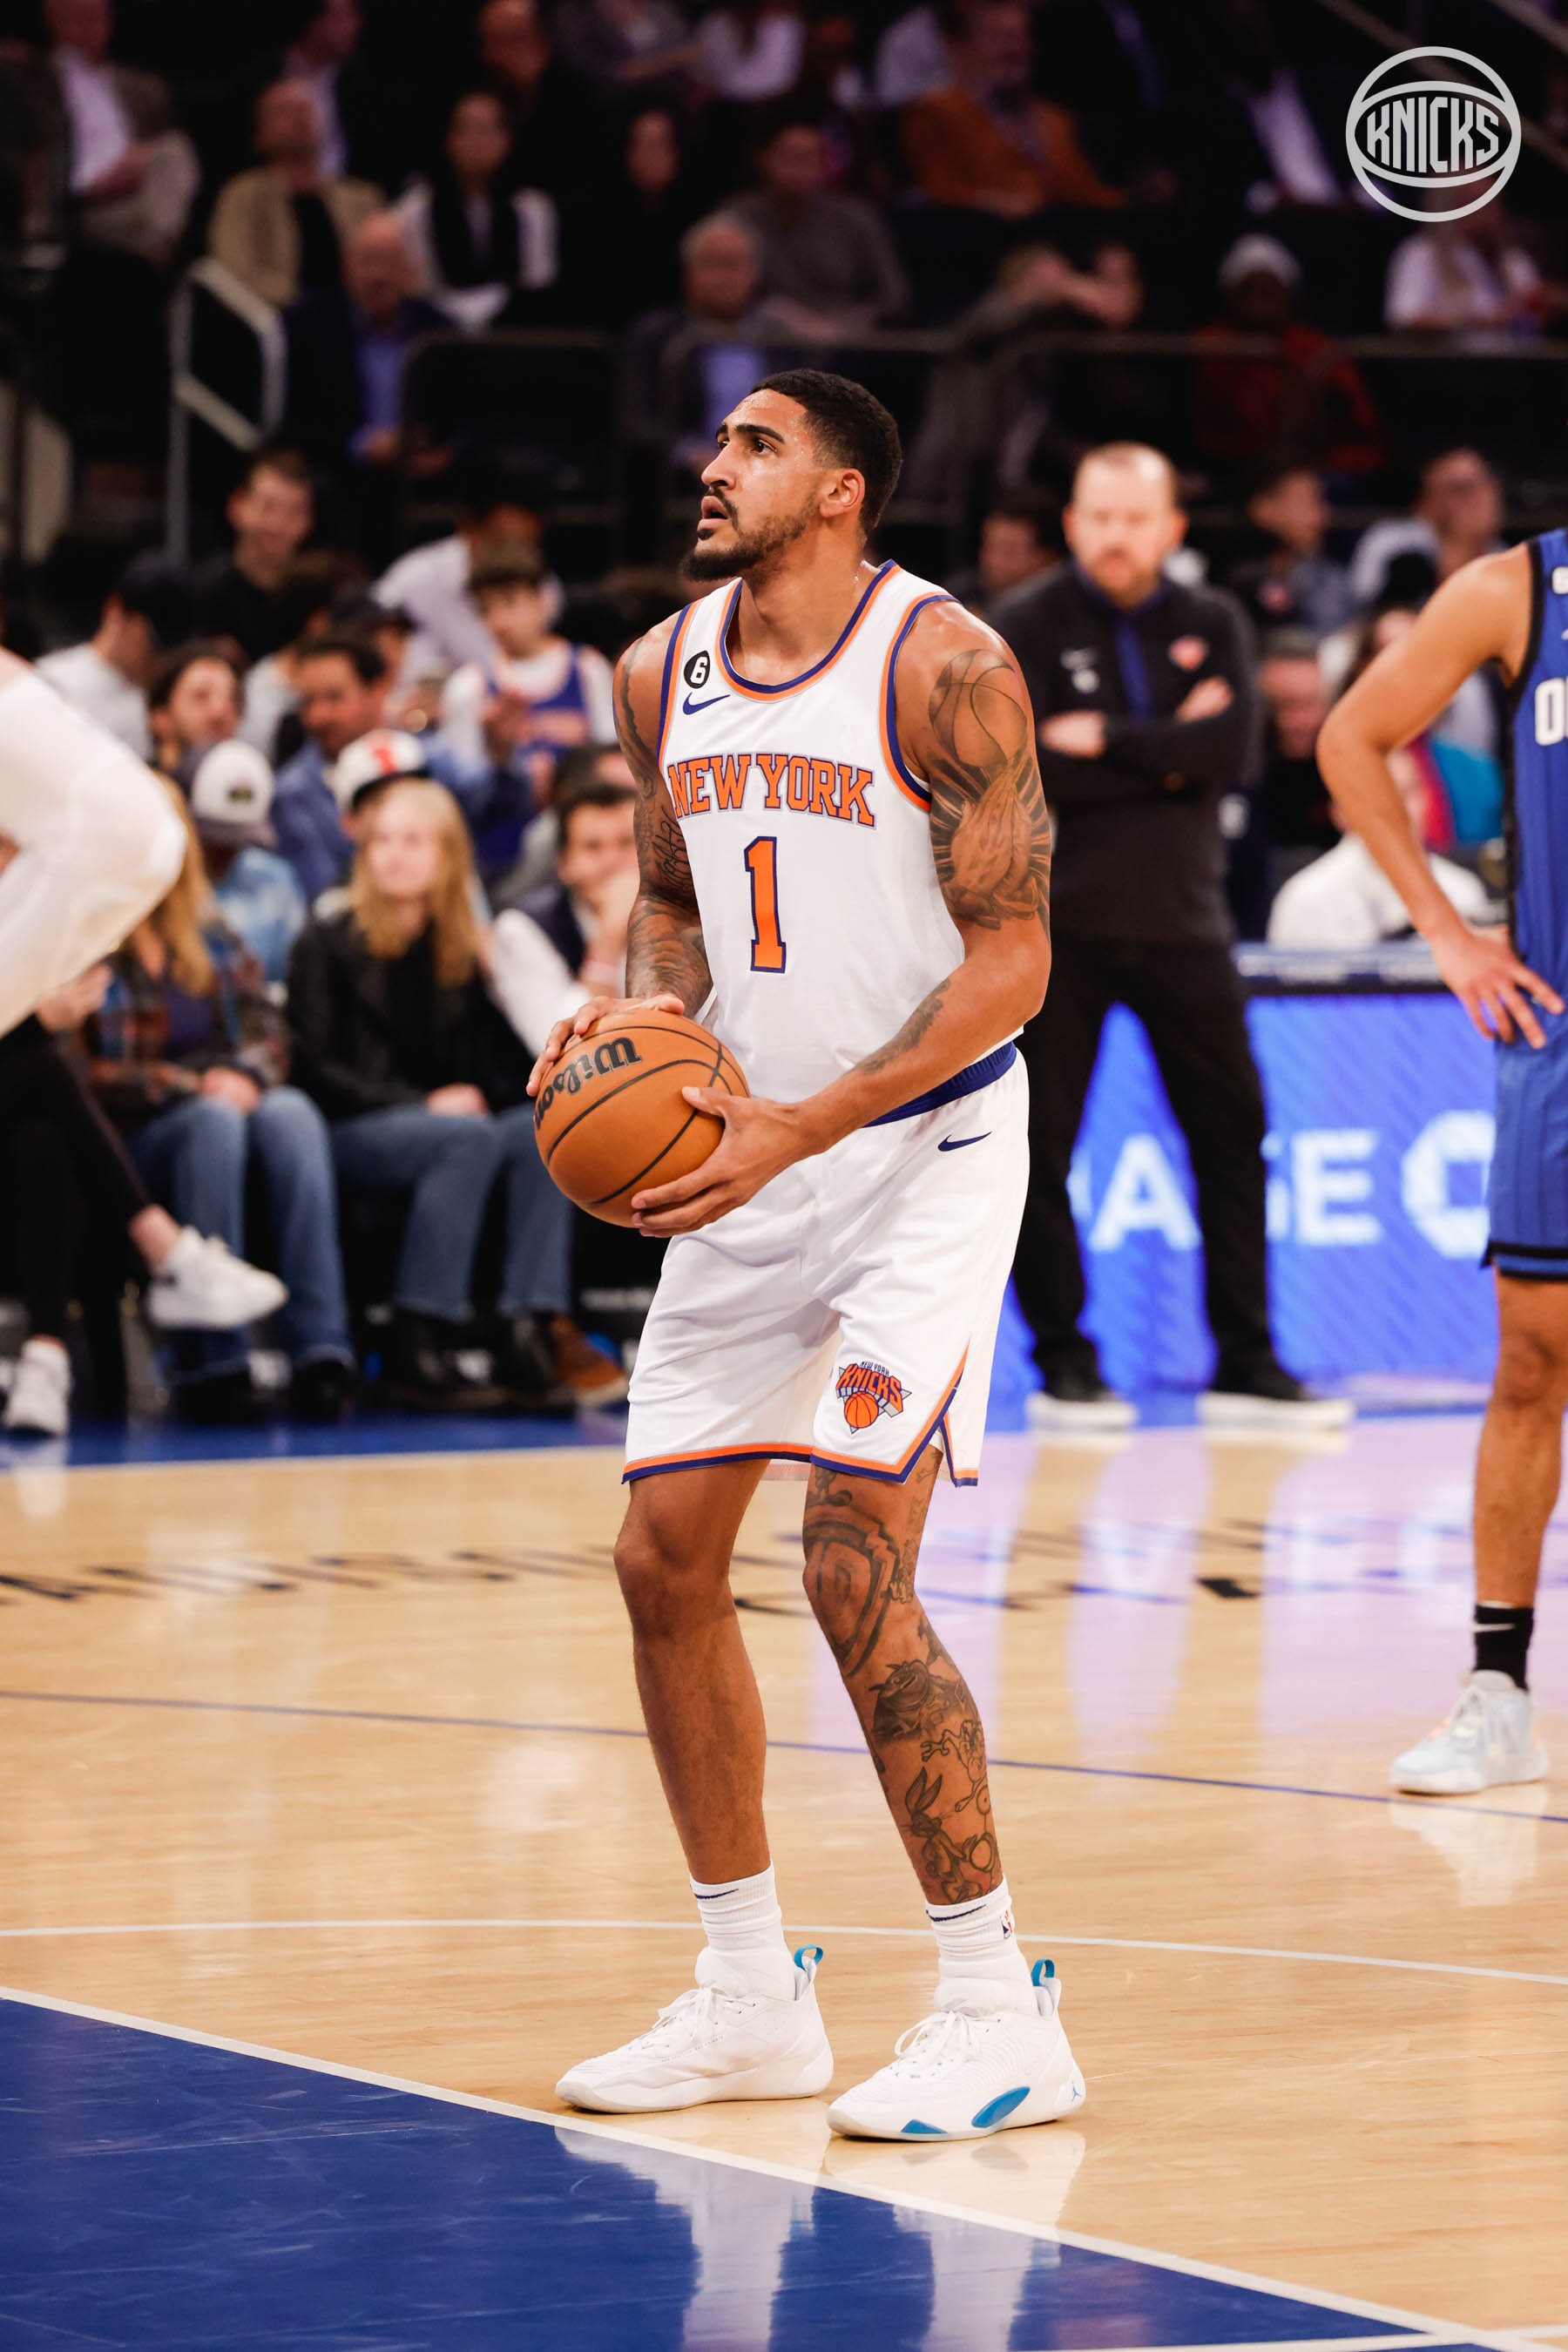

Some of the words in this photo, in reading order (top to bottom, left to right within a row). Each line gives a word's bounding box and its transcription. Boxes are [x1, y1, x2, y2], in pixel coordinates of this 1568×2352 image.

[690, 656, 707, 684] 6
[667, 754, 752, 821] NEW
[755, 753, 875, 828] YORK
[743, 835, 787, 973] 1
[835, 1363, 903, 1413] KNICKS
